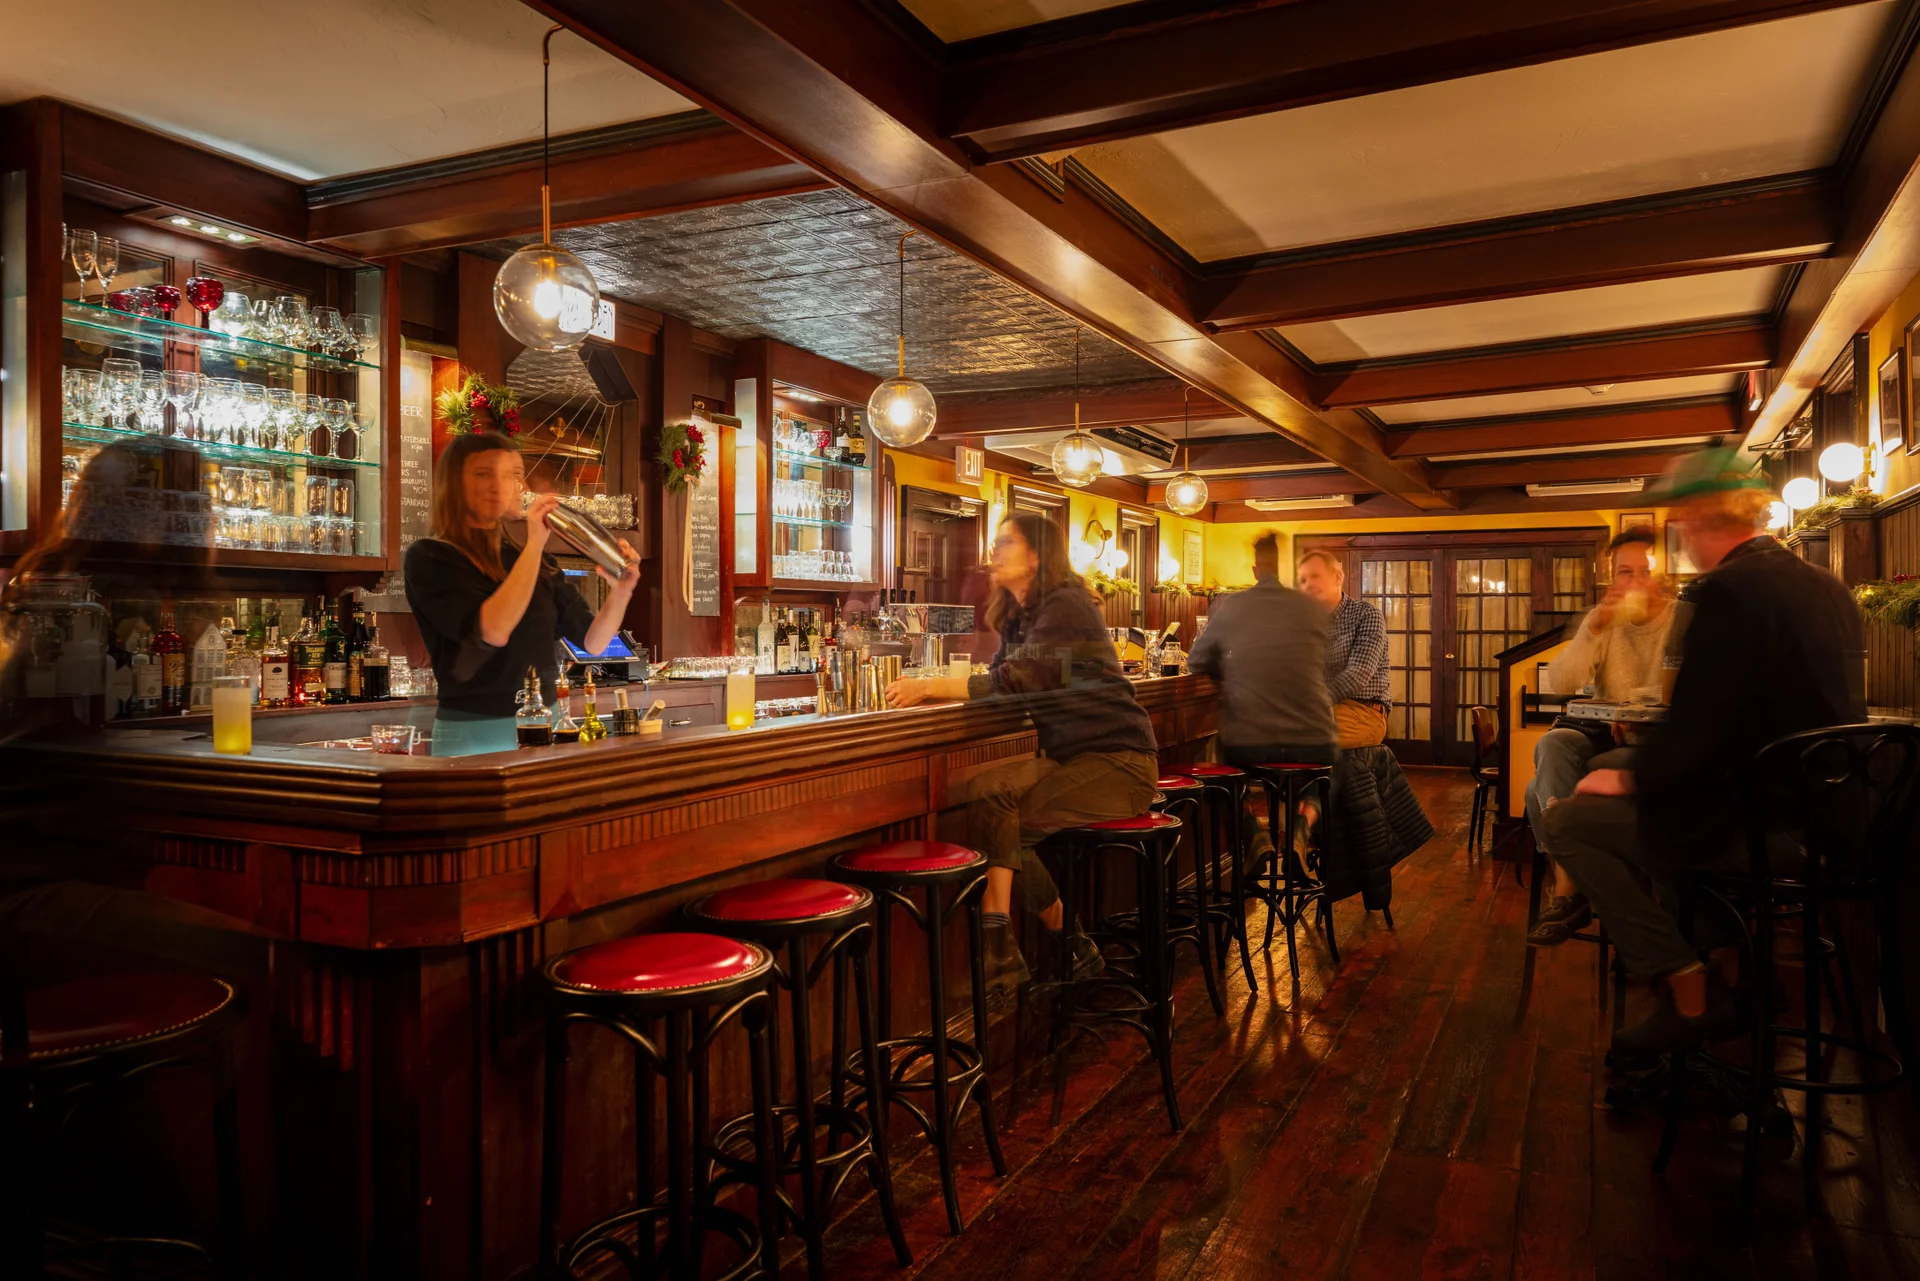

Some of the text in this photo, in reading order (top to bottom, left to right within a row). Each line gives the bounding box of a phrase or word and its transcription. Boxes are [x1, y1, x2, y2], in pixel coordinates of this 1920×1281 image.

[400, 404, 423, 418] BEER
[965, 449, 981, 478] EXIT
[400, 497, 430, 508] STANDARD
